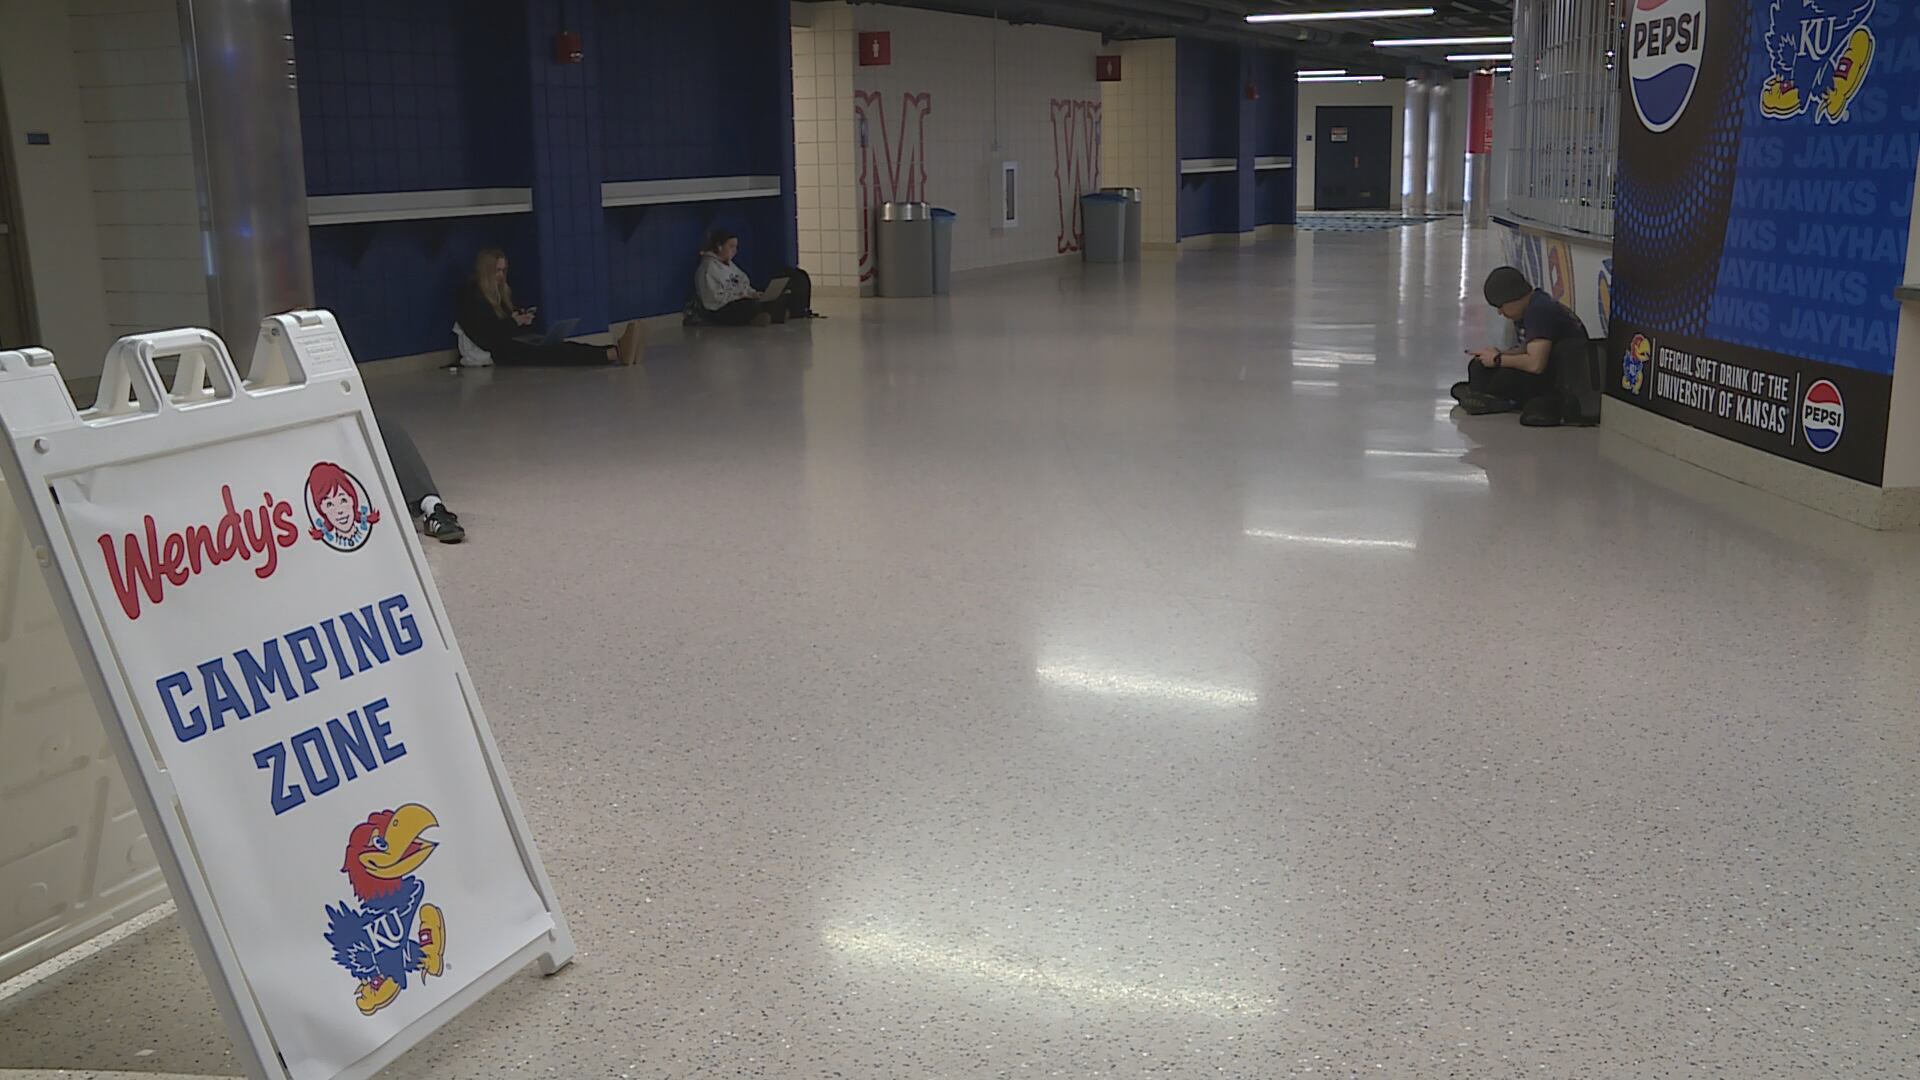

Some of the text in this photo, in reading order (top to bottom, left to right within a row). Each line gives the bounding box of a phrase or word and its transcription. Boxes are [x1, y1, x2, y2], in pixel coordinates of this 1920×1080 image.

[1632, 11, 1701, 60] PEPSI
[1797, 16, 1837, 61] KU
[1793, 134, 1919, 169] JAYHA
[1787, 223, 1908, 265] JAYHA
[1780, 306, 1897, 356] JAYHA
[1658, 347, 1694, 376] OFFICIAL
[1695, 356, 1718, 381] SOFT
[1719, 363, 1749, 393] DRINK
[1750, 369, 1766, 395] OF
[1767, 374, 1790, 402] THE
[1657, 371, 1787, 435] UNIVERSITY OF KANSAS
[1804, 404, 1842, 428] PEPSI
[97, 484, 299, 620] Wendy's
[156, 594, 423, 743] CAMPING
[252, 697, 408, 816] ZONE
[363, 908, 405, 954] KU
